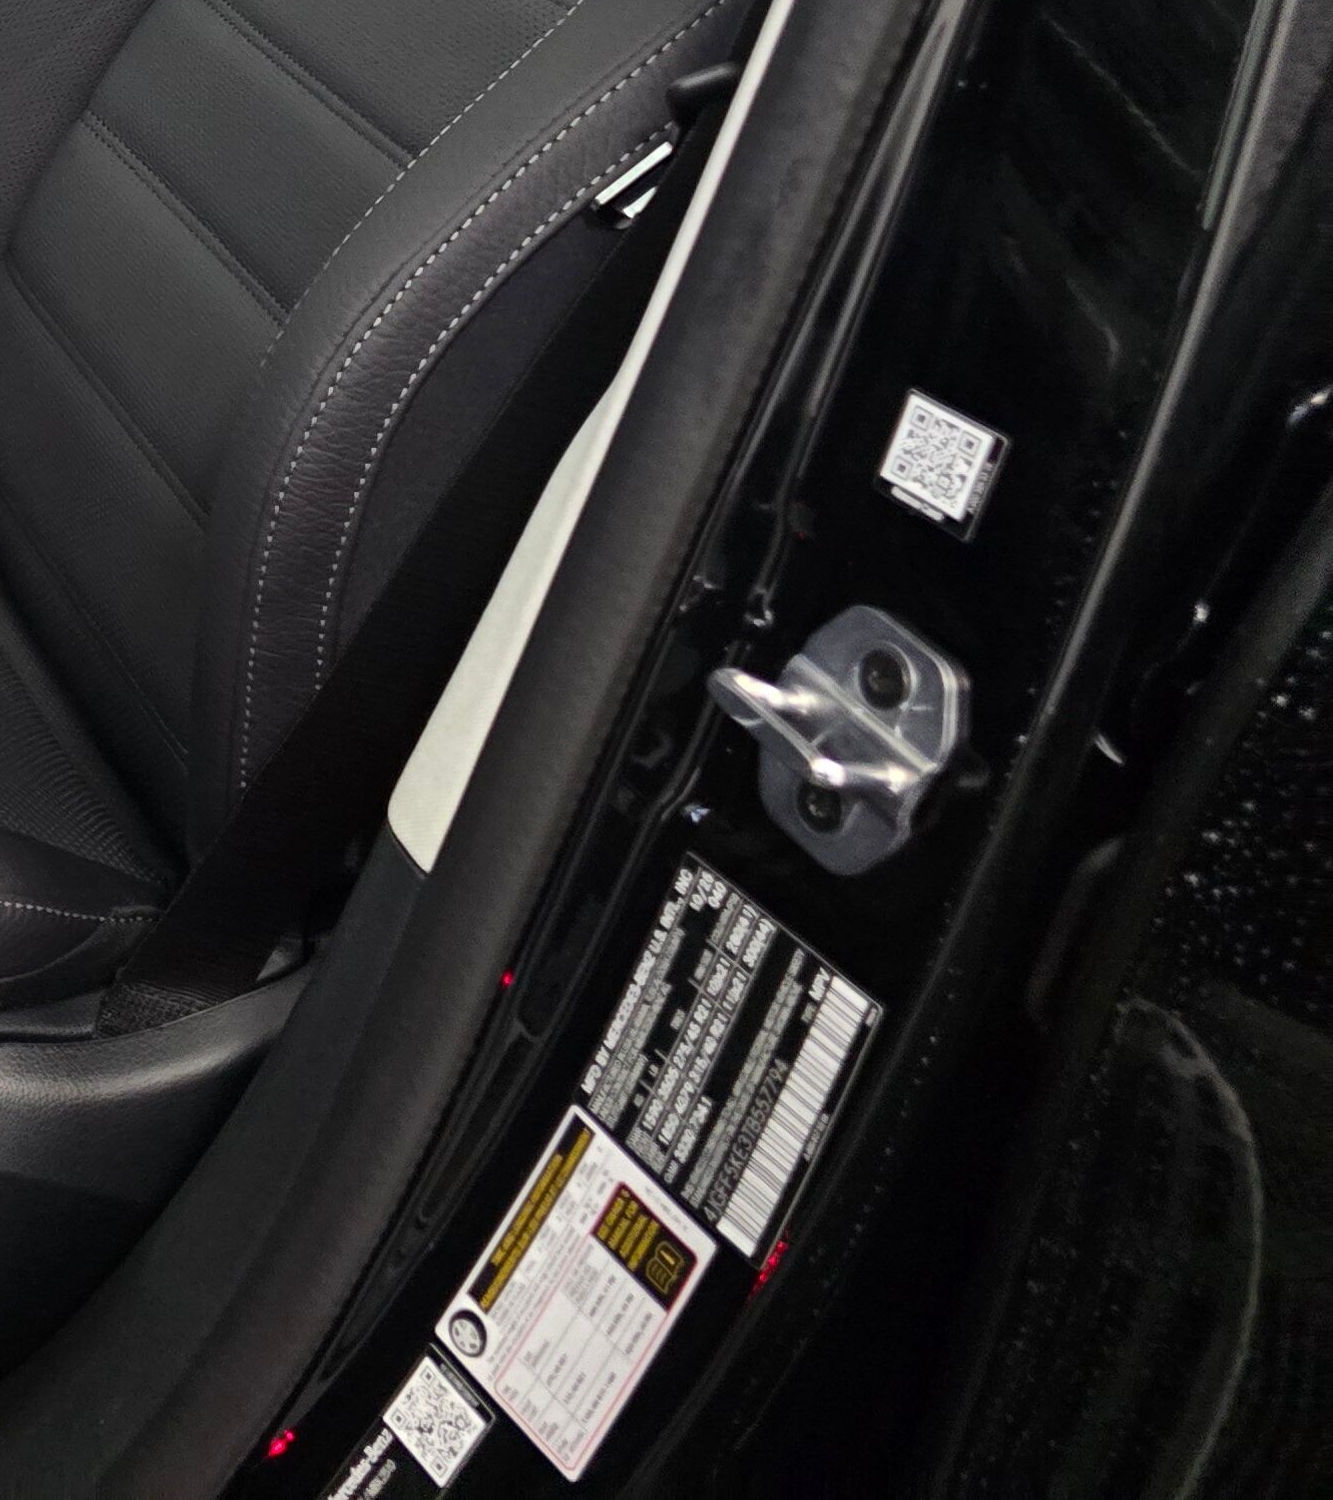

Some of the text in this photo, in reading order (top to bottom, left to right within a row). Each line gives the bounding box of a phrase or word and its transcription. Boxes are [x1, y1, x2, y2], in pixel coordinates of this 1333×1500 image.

[595, 1045, 610, 1066] BY
[603, 949, 656, 1051] MERCEDES-BENZ
[674, 867, 693, 895] INC
[807, 966, 831, 1001] MPV
[672, 1019, 702, 1069] 275/45
[693, 997, 711, 1024] R21
[673, 1080, 695, 1115] 4079
[688, 1034, 719, 1084] 315/40
